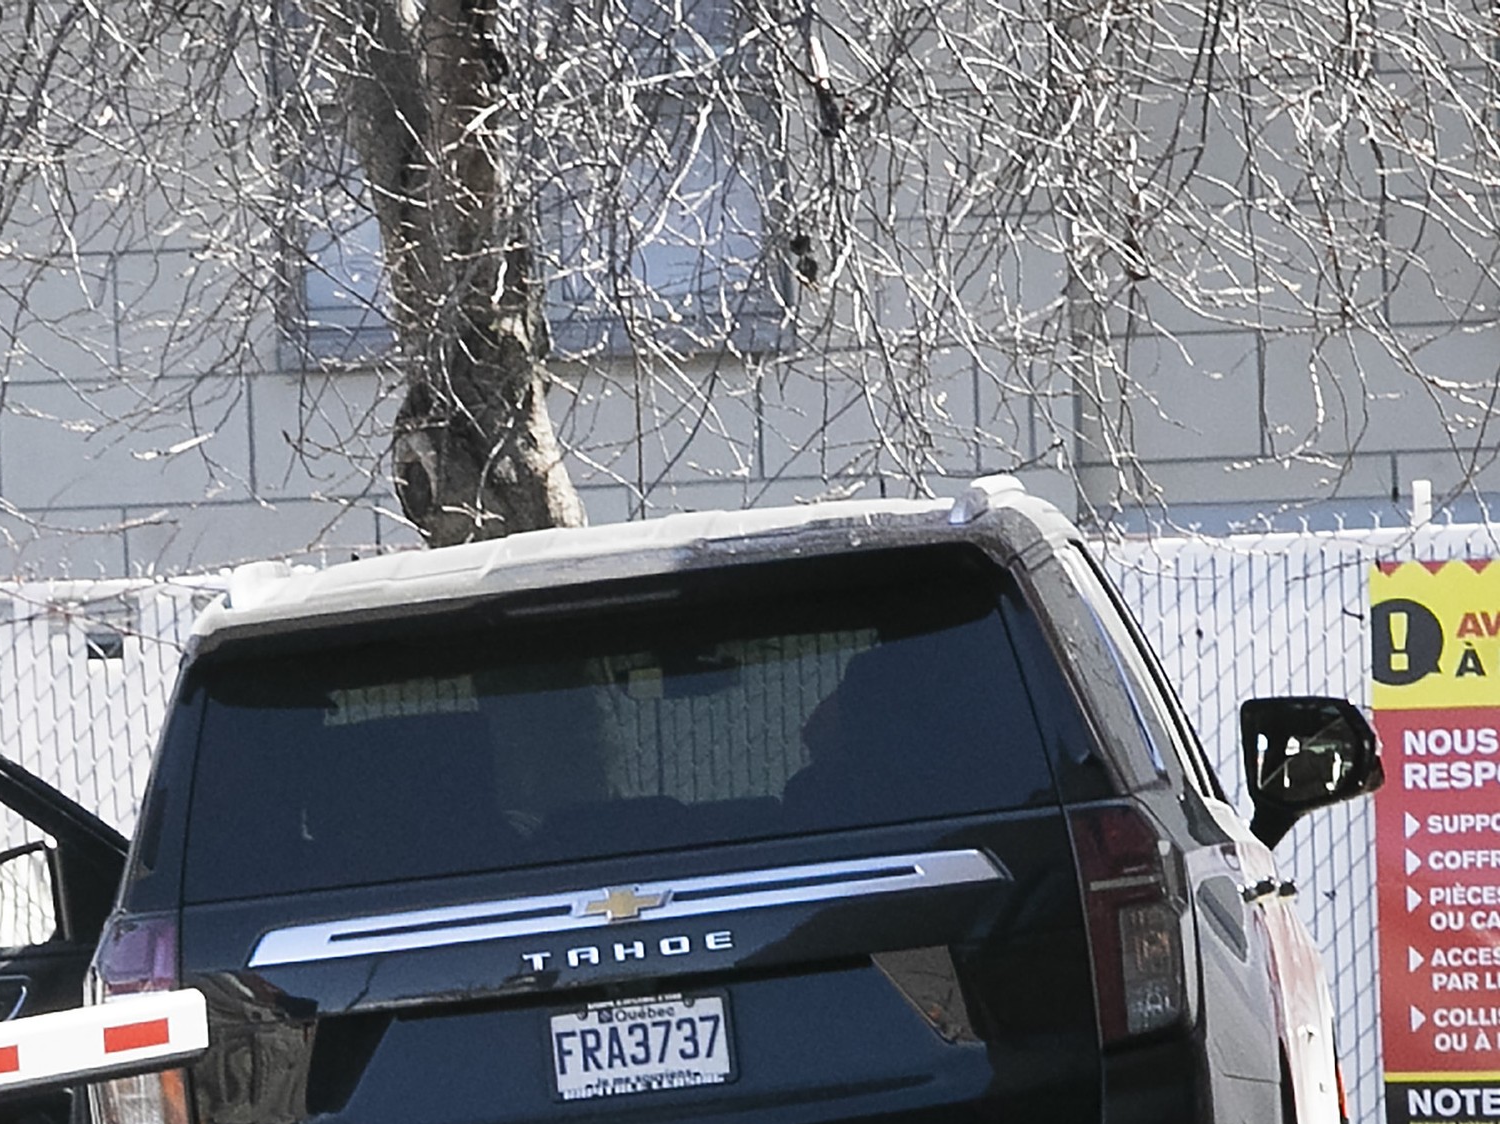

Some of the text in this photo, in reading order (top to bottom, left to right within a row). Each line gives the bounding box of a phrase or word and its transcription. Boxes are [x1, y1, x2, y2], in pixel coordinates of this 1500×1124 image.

[1455, 642, 1486, 677] À
[1404, 729, 1498, 756] NOUS
[1404, 762, 1500, 790] RESP
[1430, 882, 1500, 906] PIÈCE
[1430, 912, 1464, 930] OU
[523, 930, 733, 971] TAHOE
[1432, 972, 1479, 991] PAR
[615, 1005, 675, 1022] Québec
[1433, 1007, 1500, 1027] COLLI
[555, 1014, 720, 1075] FRA3737
[1434, 1029, 1491, 1052] OU À
